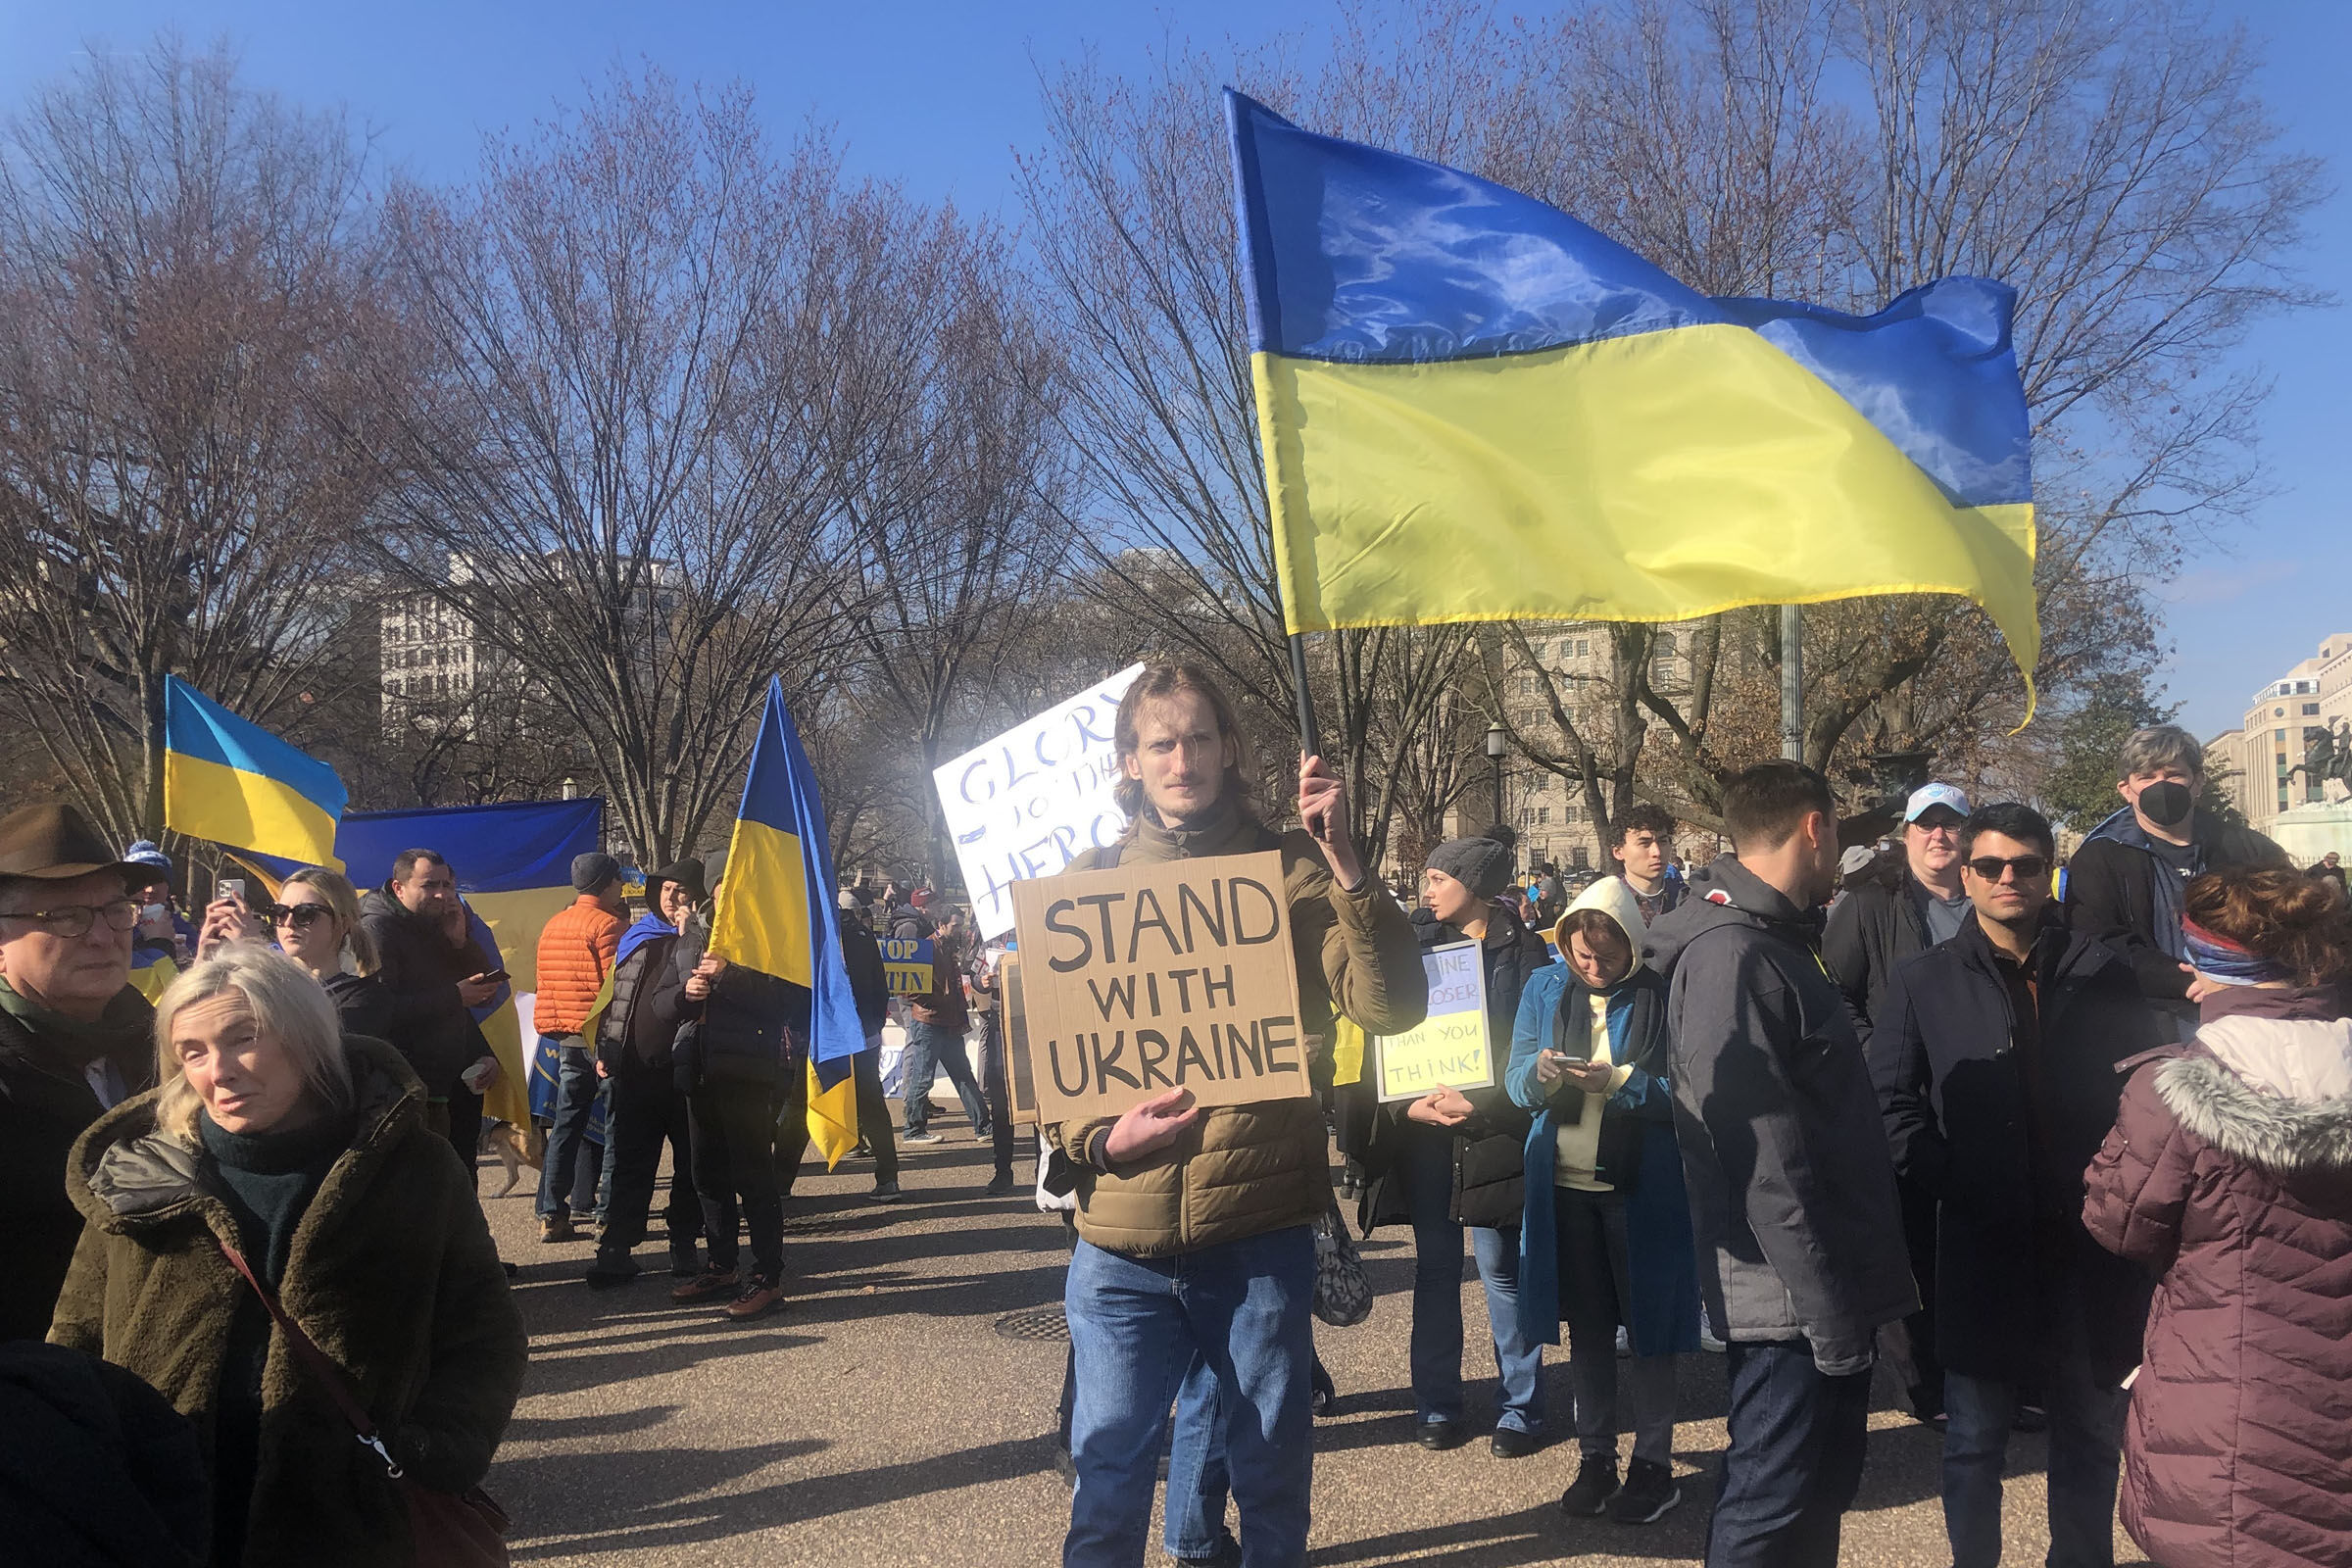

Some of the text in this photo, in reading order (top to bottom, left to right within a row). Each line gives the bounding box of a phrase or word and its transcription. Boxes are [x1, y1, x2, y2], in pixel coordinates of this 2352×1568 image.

[1045, 876, 1280, 973] STAND
[1087, 963, 1237, 1023] WITH
[1049, 1015, 1299, 1097] UKRAINE
[1387, 1024, 1478, 1049] THAN YOU
